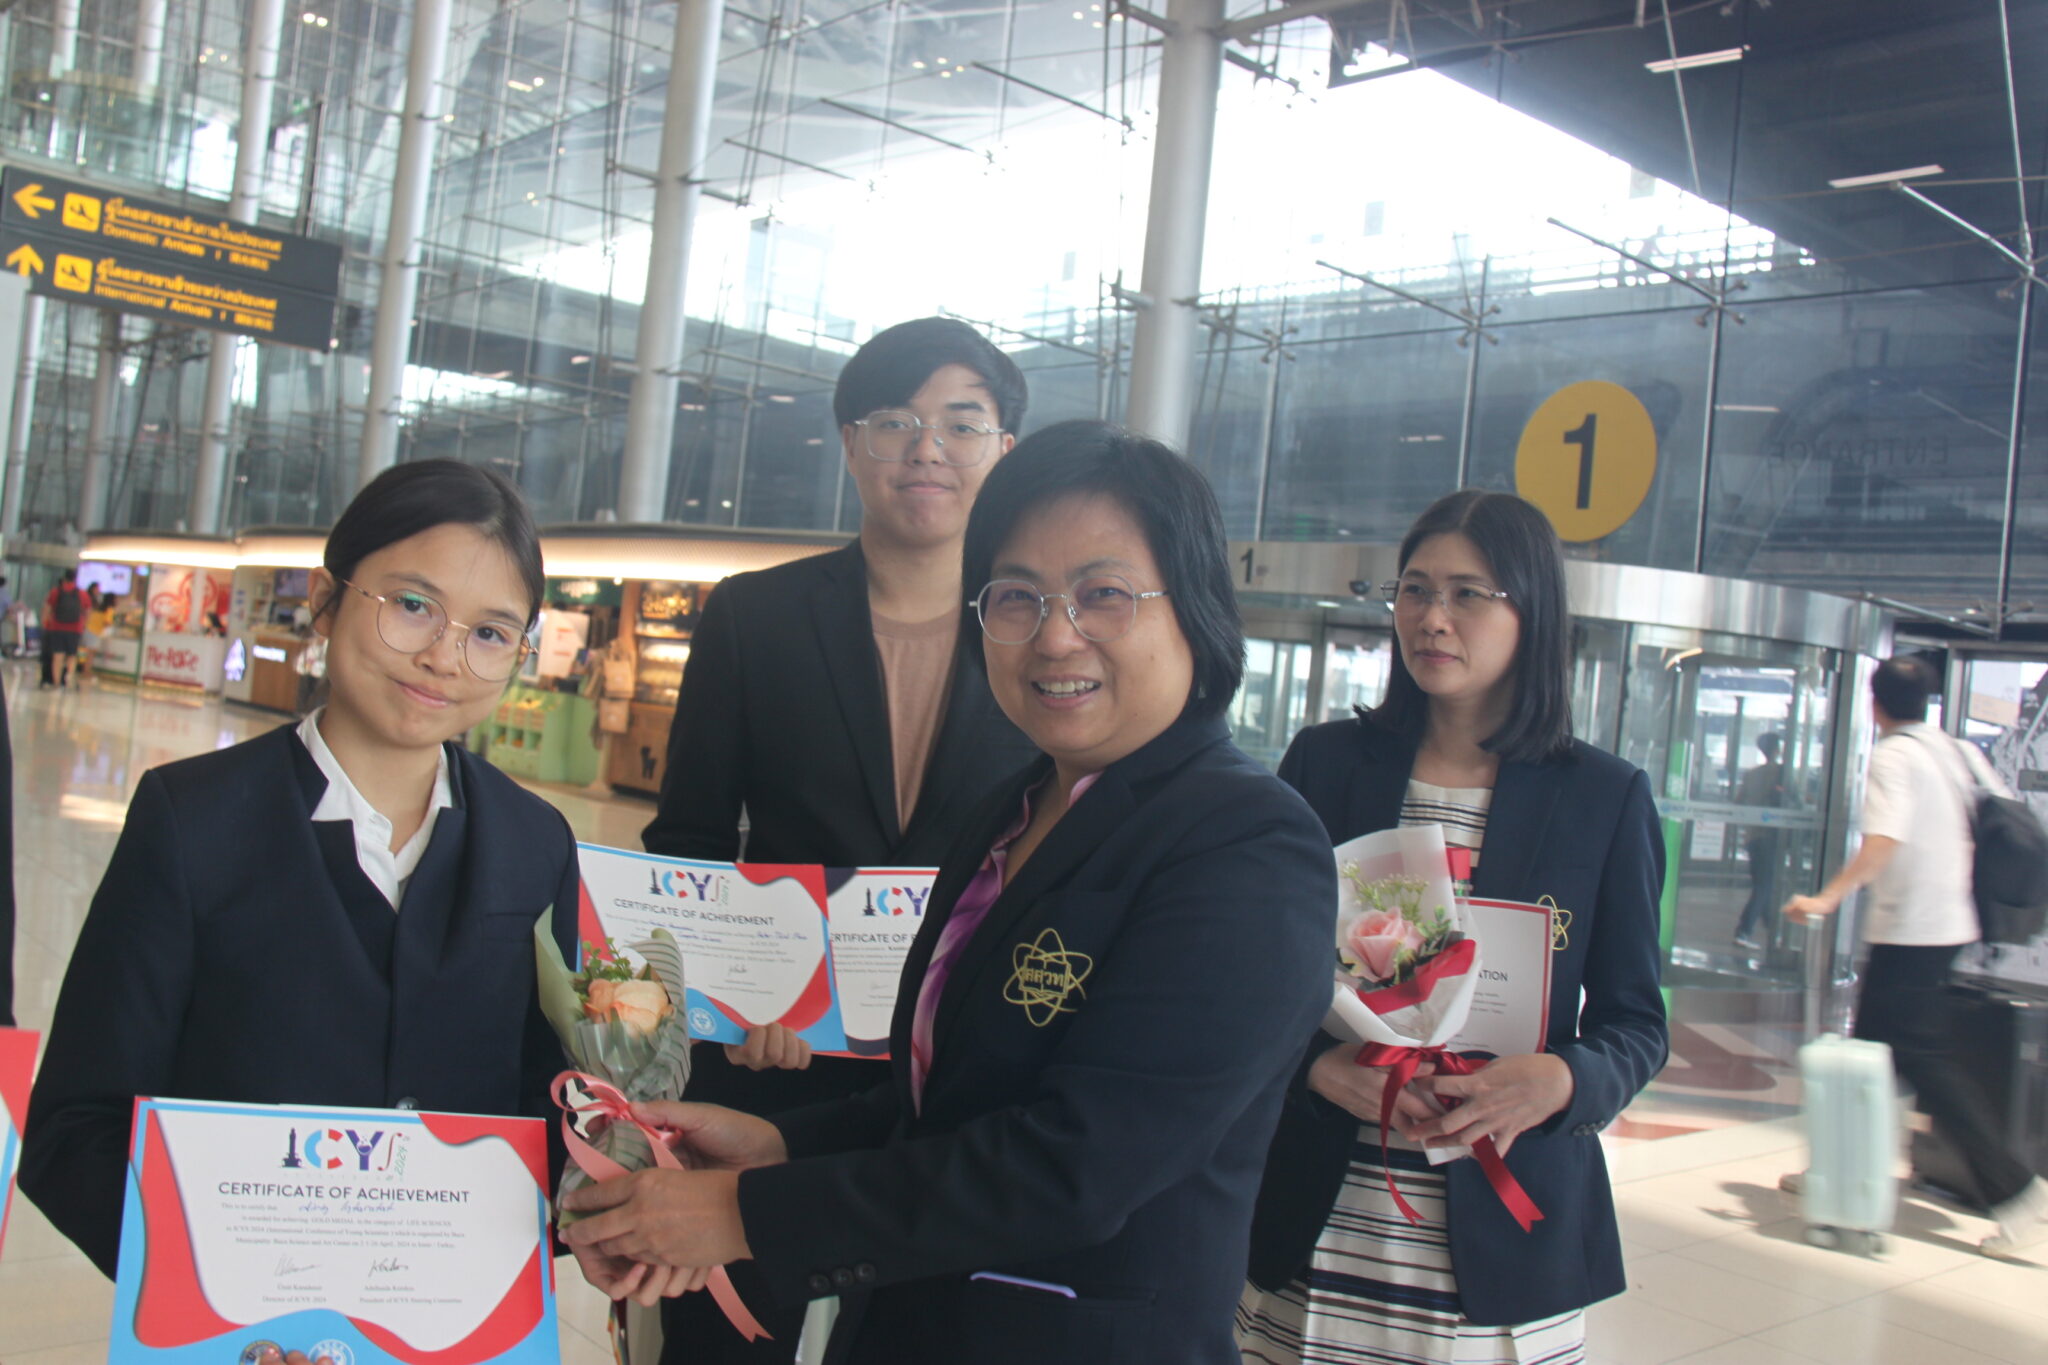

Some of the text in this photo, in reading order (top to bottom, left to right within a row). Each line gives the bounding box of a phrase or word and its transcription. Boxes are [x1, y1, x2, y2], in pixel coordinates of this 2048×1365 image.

[103, 223, 205, 257] Domestic Arrivals
[94, 283, 212, 319] International Arrivals
[1562, 412, 1597, 510] 1
[1241, 548, 1254, 585] 1
[613, 898, 775, 926] CERTIFICATE OF ACHIEVEMENT
[892, 934, 908, 943] OF
[218, 1182, 469, 1203] CERTIFICATE OF ACHIEVEMENT
